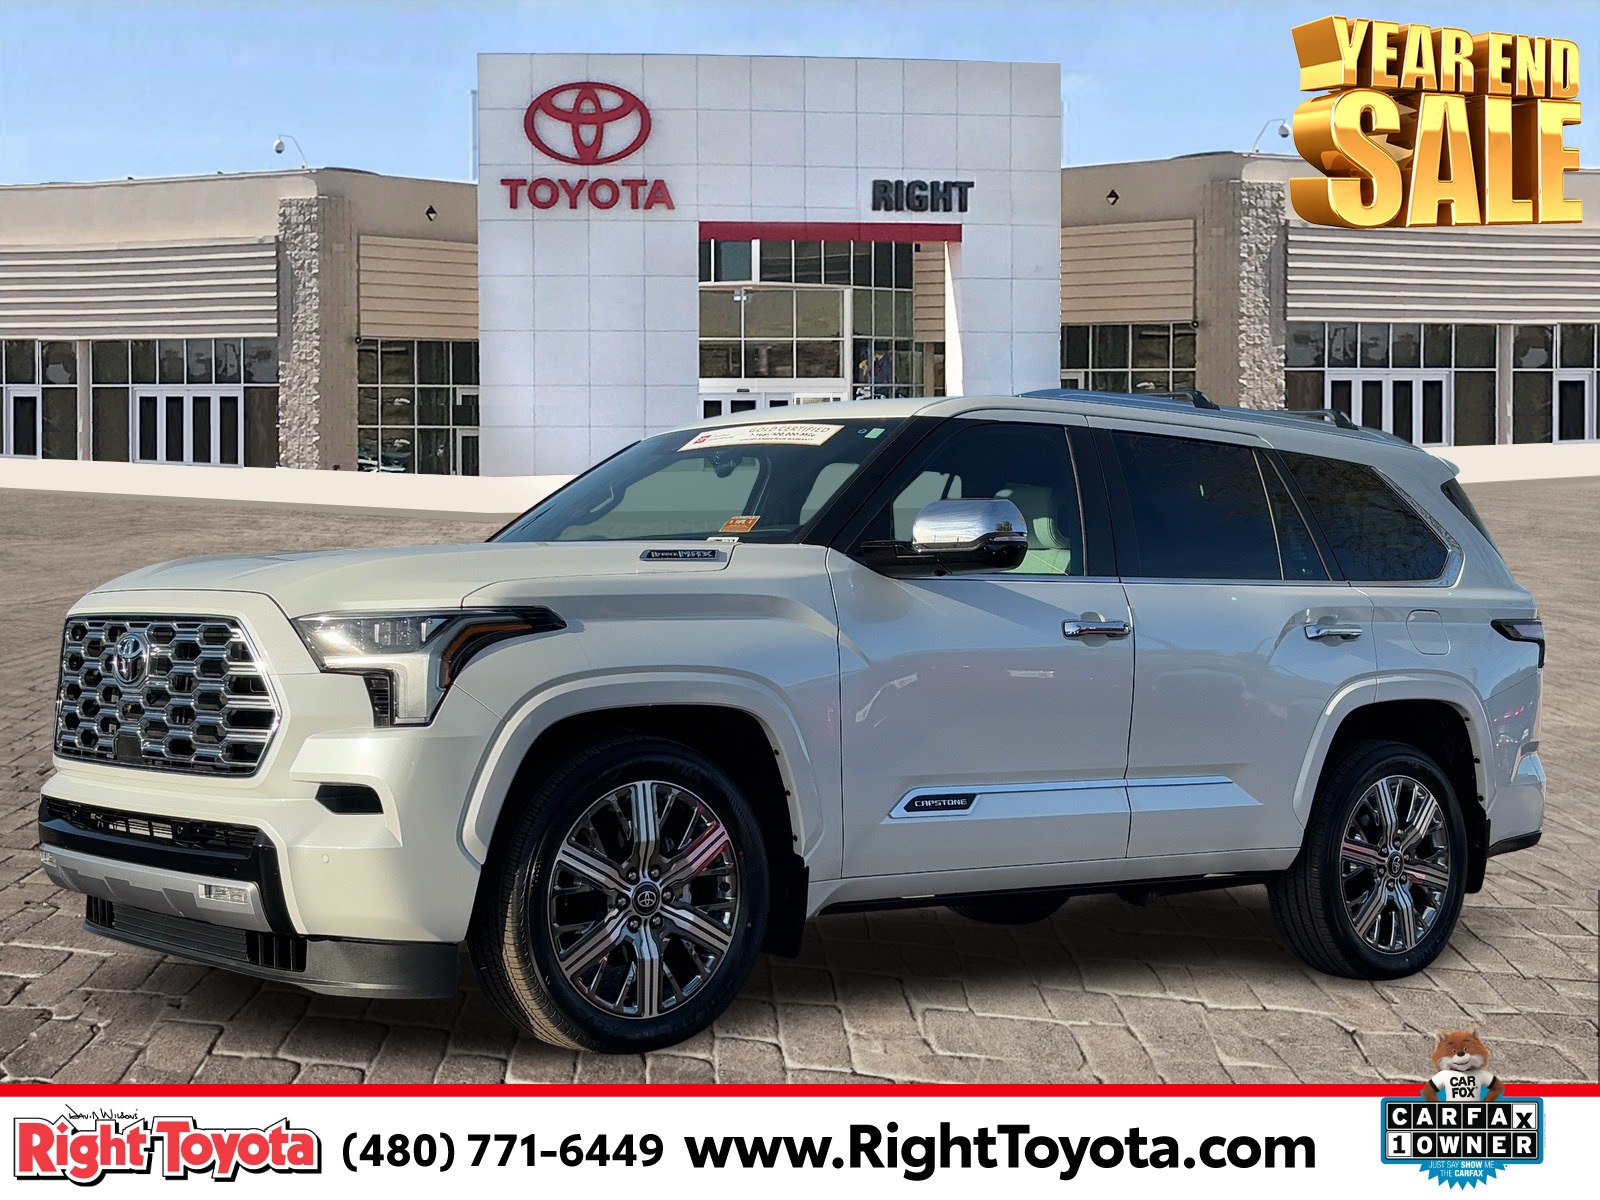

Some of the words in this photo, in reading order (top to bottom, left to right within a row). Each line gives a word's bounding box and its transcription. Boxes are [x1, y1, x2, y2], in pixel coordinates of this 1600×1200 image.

[500, 178, 676, 210] TOYOTA
[871, 179, 975, 213] RIGHT
[748, 426, 778, 434] GOLD
[777, 425, 831, 434] CERTIFIED
[914, 799, 968, 807] CAPSTONE
